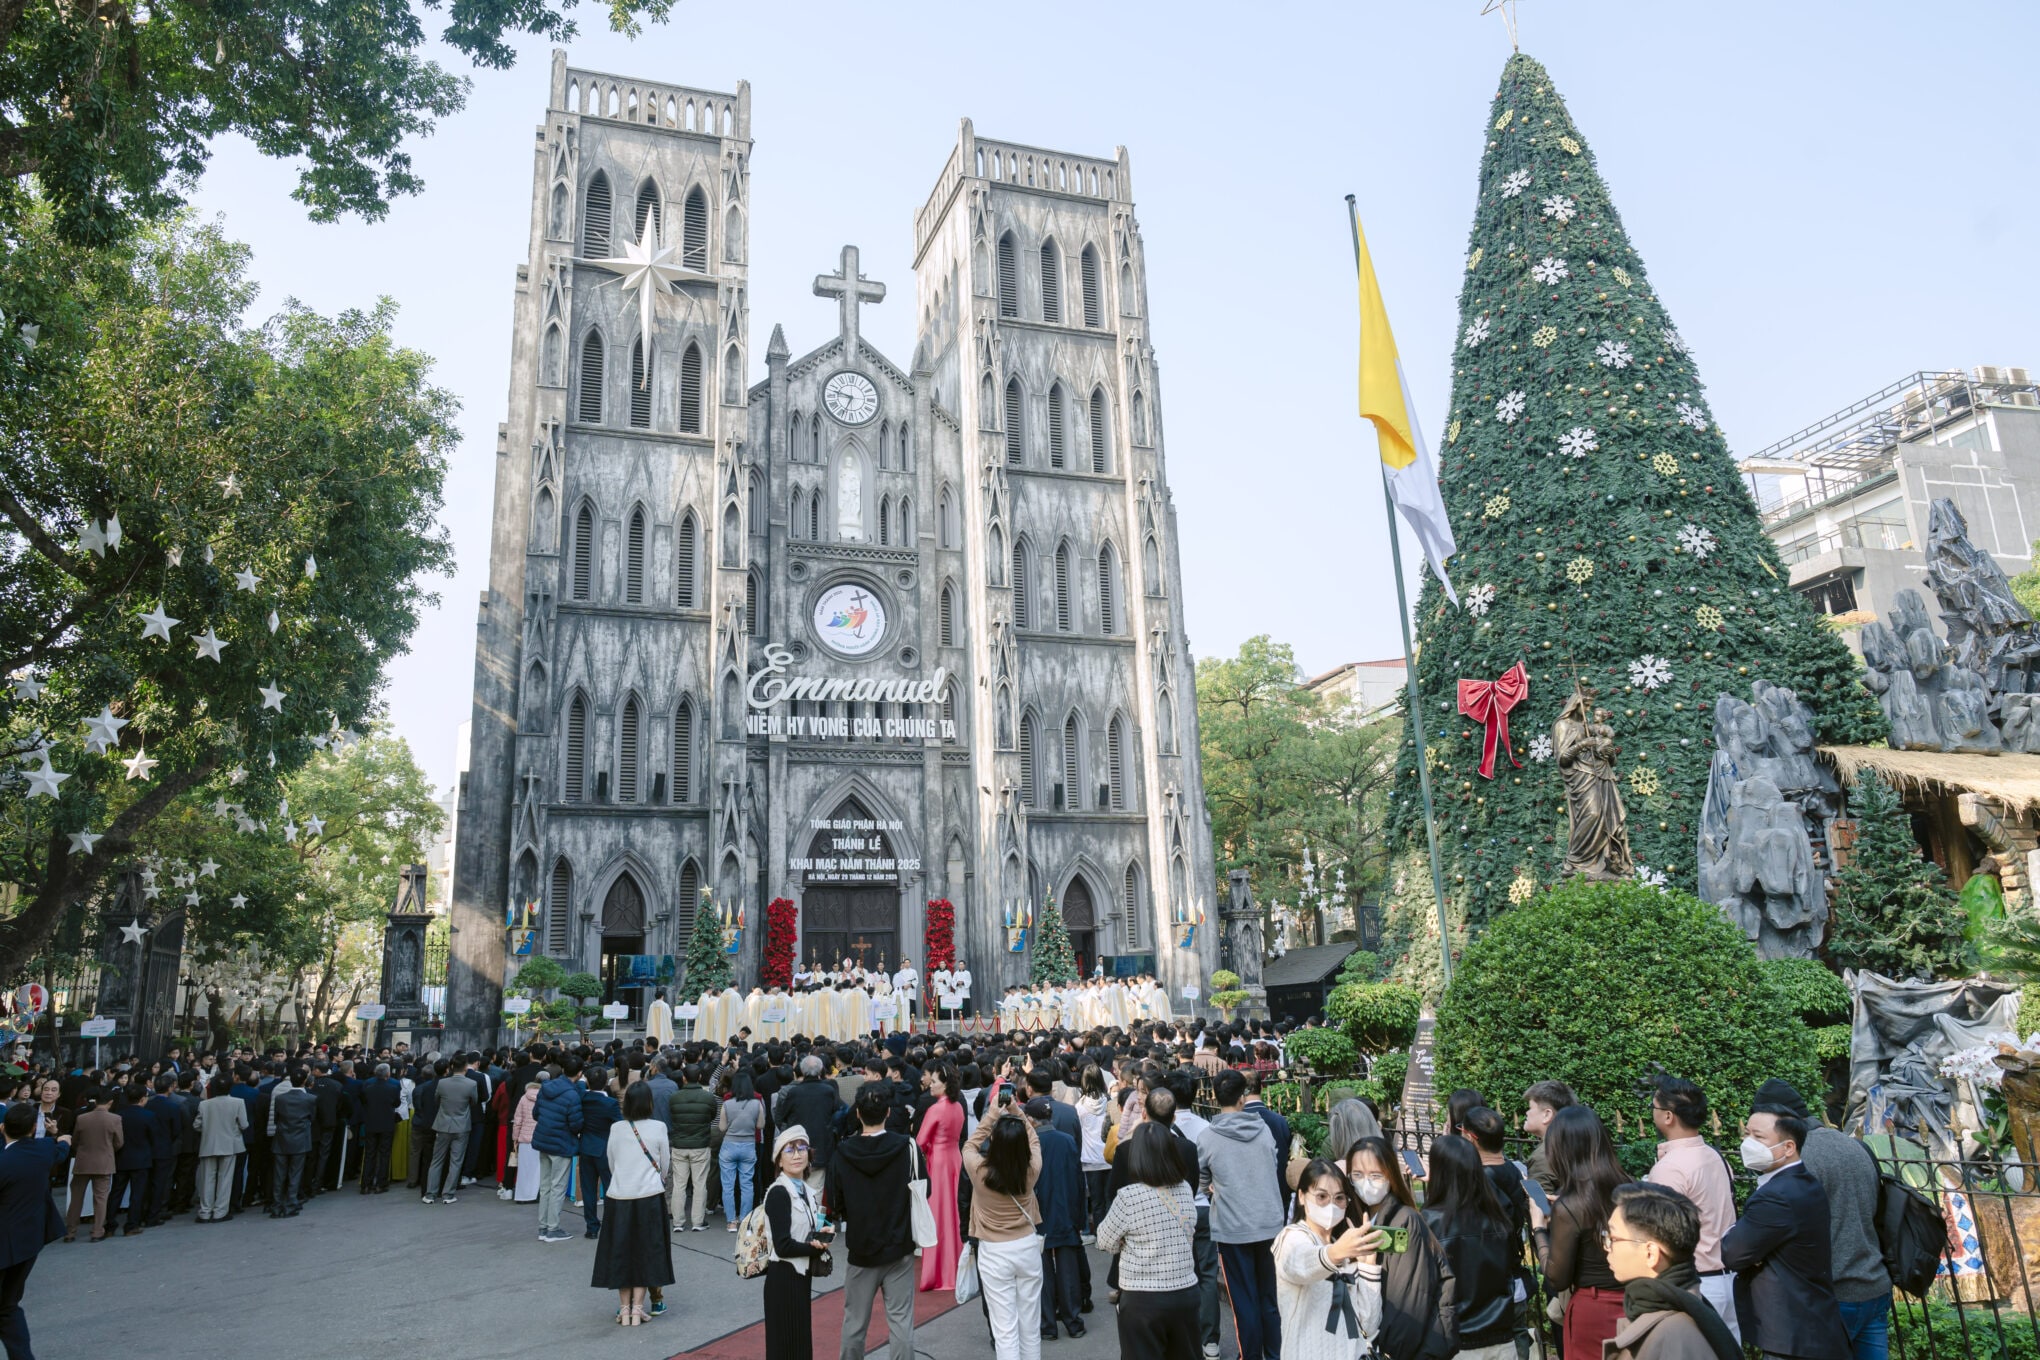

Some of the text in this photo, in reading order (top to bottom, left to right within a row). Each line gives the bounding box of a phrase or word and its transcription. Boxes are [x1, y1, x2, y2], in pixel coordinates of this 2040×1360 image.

[747, 642, 949, 709] Emmanuel
[786, 715, 806, 736] HY
[809, 716, 849, 740] VỌNG
[853, 712, 883, 738] CỦA
[886, 715, 936, 739] CHÚNG
[940, 719, 957, 739] TA
[810, 815, 903, 832] TỔNG GIÁO PHẬN HÀ NỘI
[832, 834, 881, 850] THÁNH LỄ
[790, 856, 921, 872] KHAI MẠC NĂM THÁNH 2025
